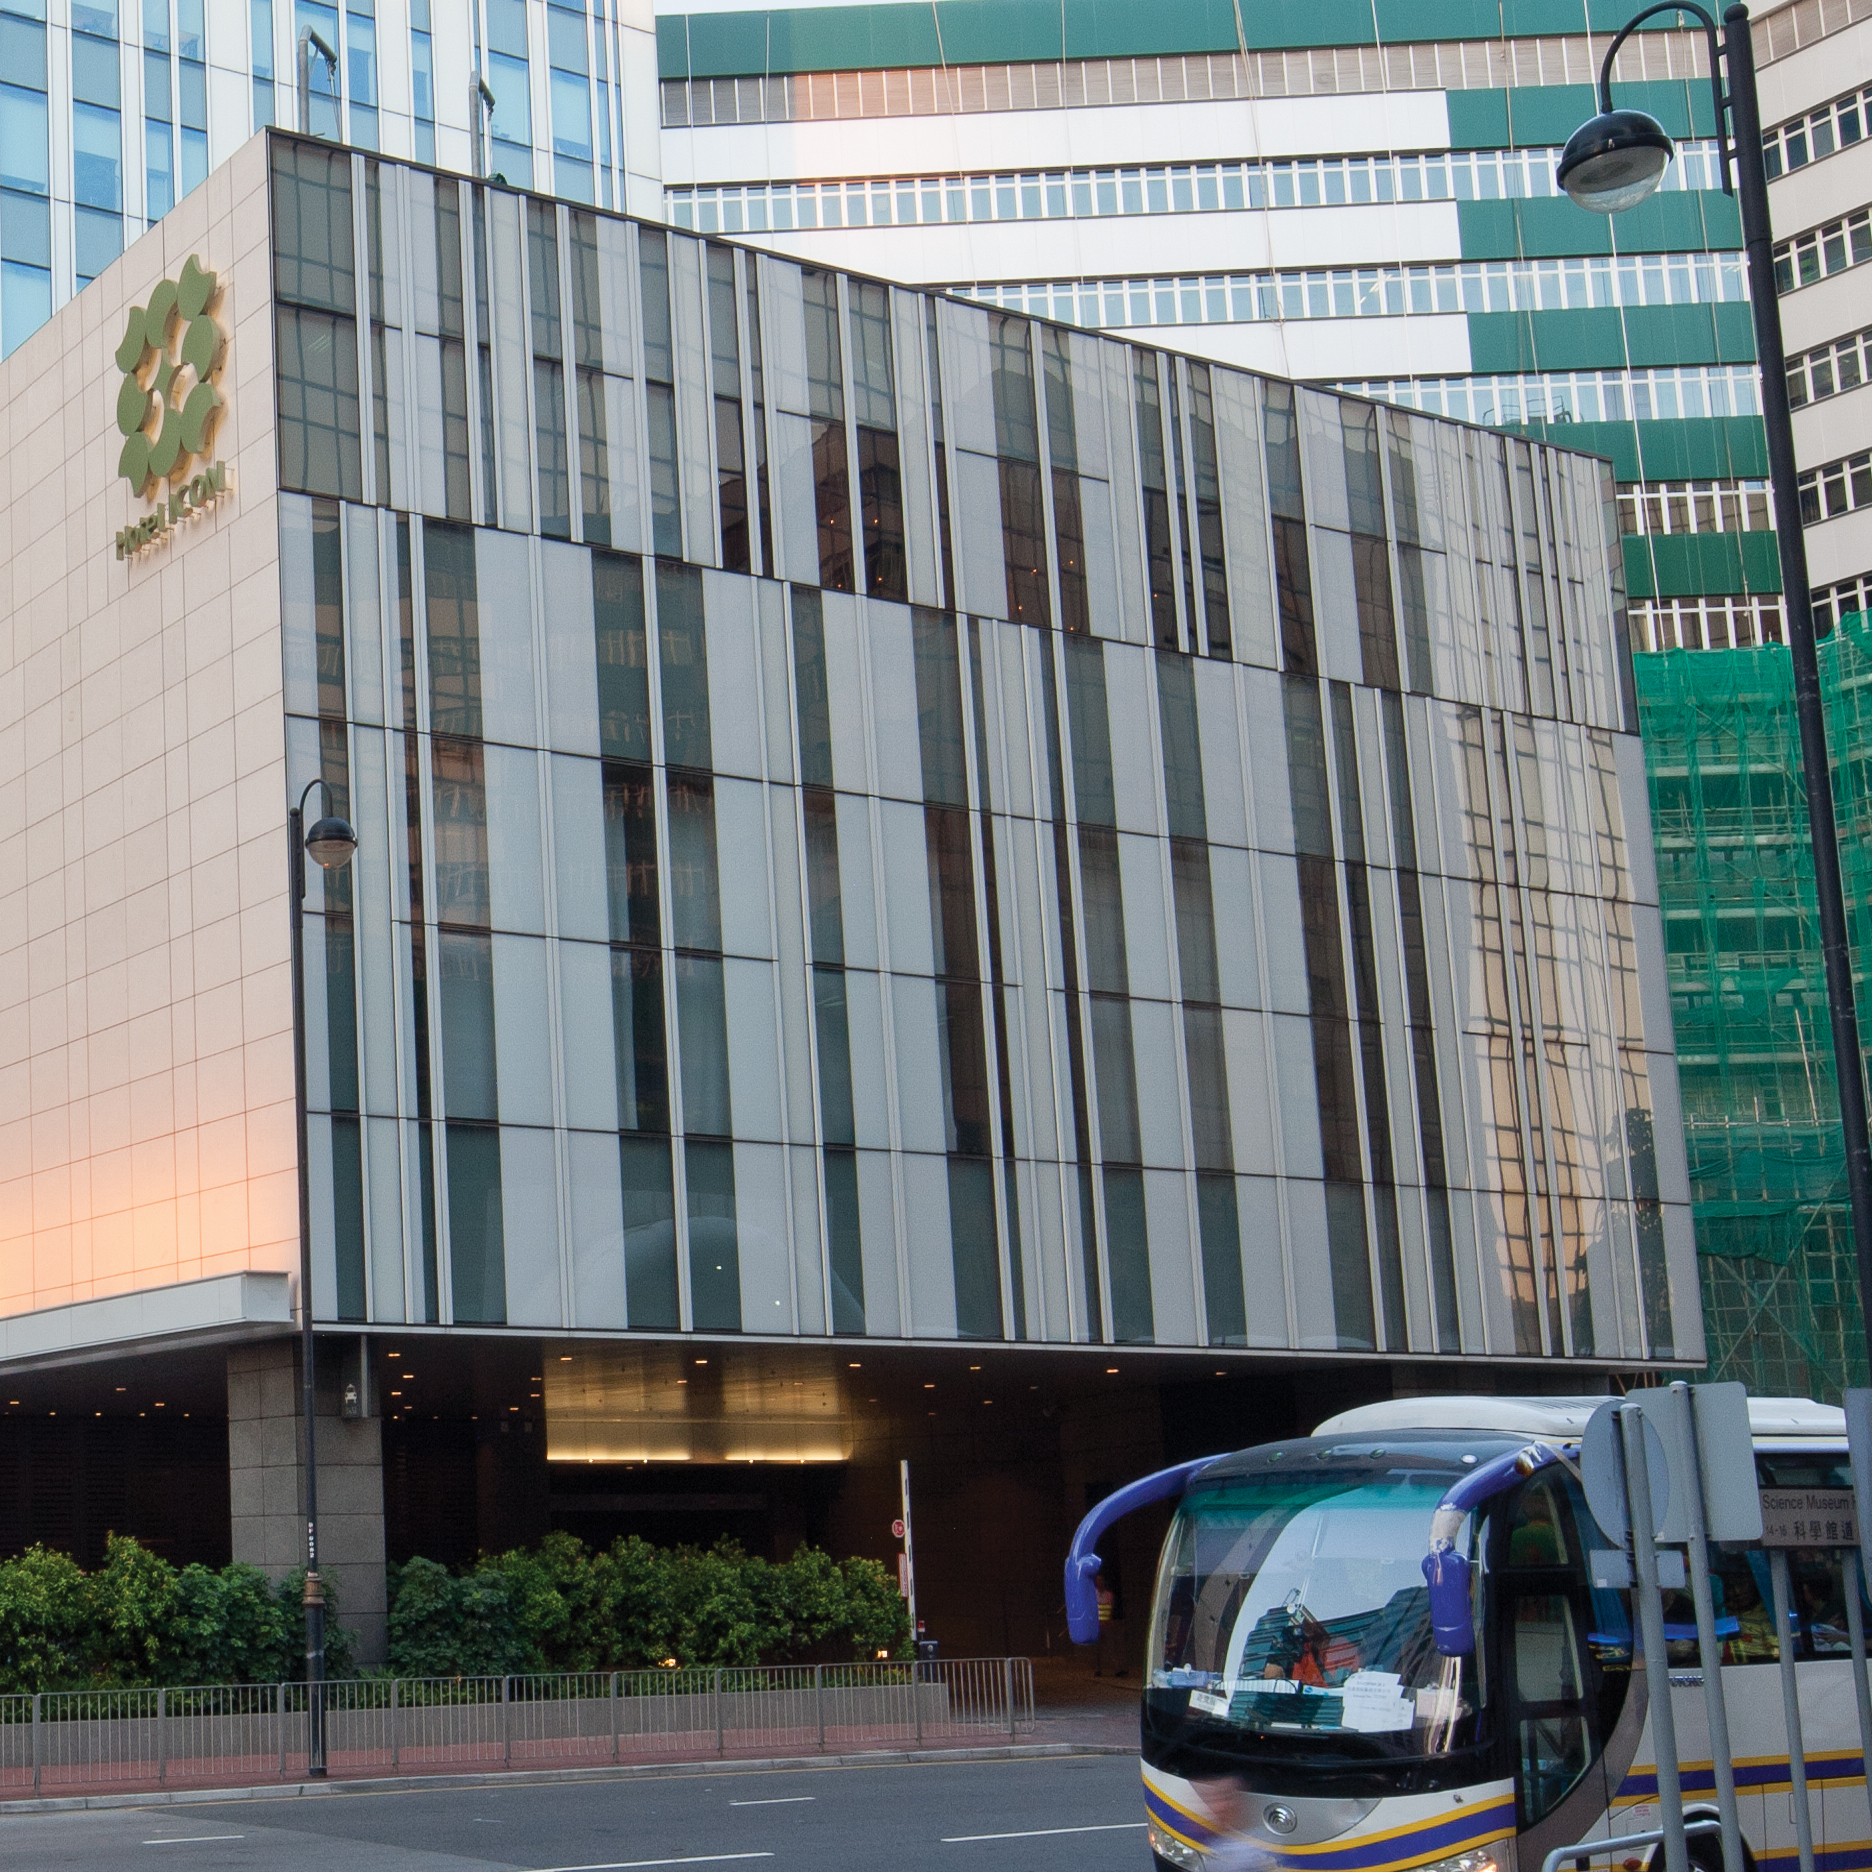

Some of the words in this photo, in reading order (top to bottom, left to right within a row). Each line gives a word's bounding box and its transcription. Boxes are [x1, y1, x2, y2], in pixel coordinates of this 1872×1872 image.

[116, 503, 167, 560] Hotel
[169, 461, 226, 524] ICON
[1762, 1494, 1803, 1510] Science
[1806, 1494, 1849, 1510] Museum
[1794, 1520, 1855, 1541] 科學館道
